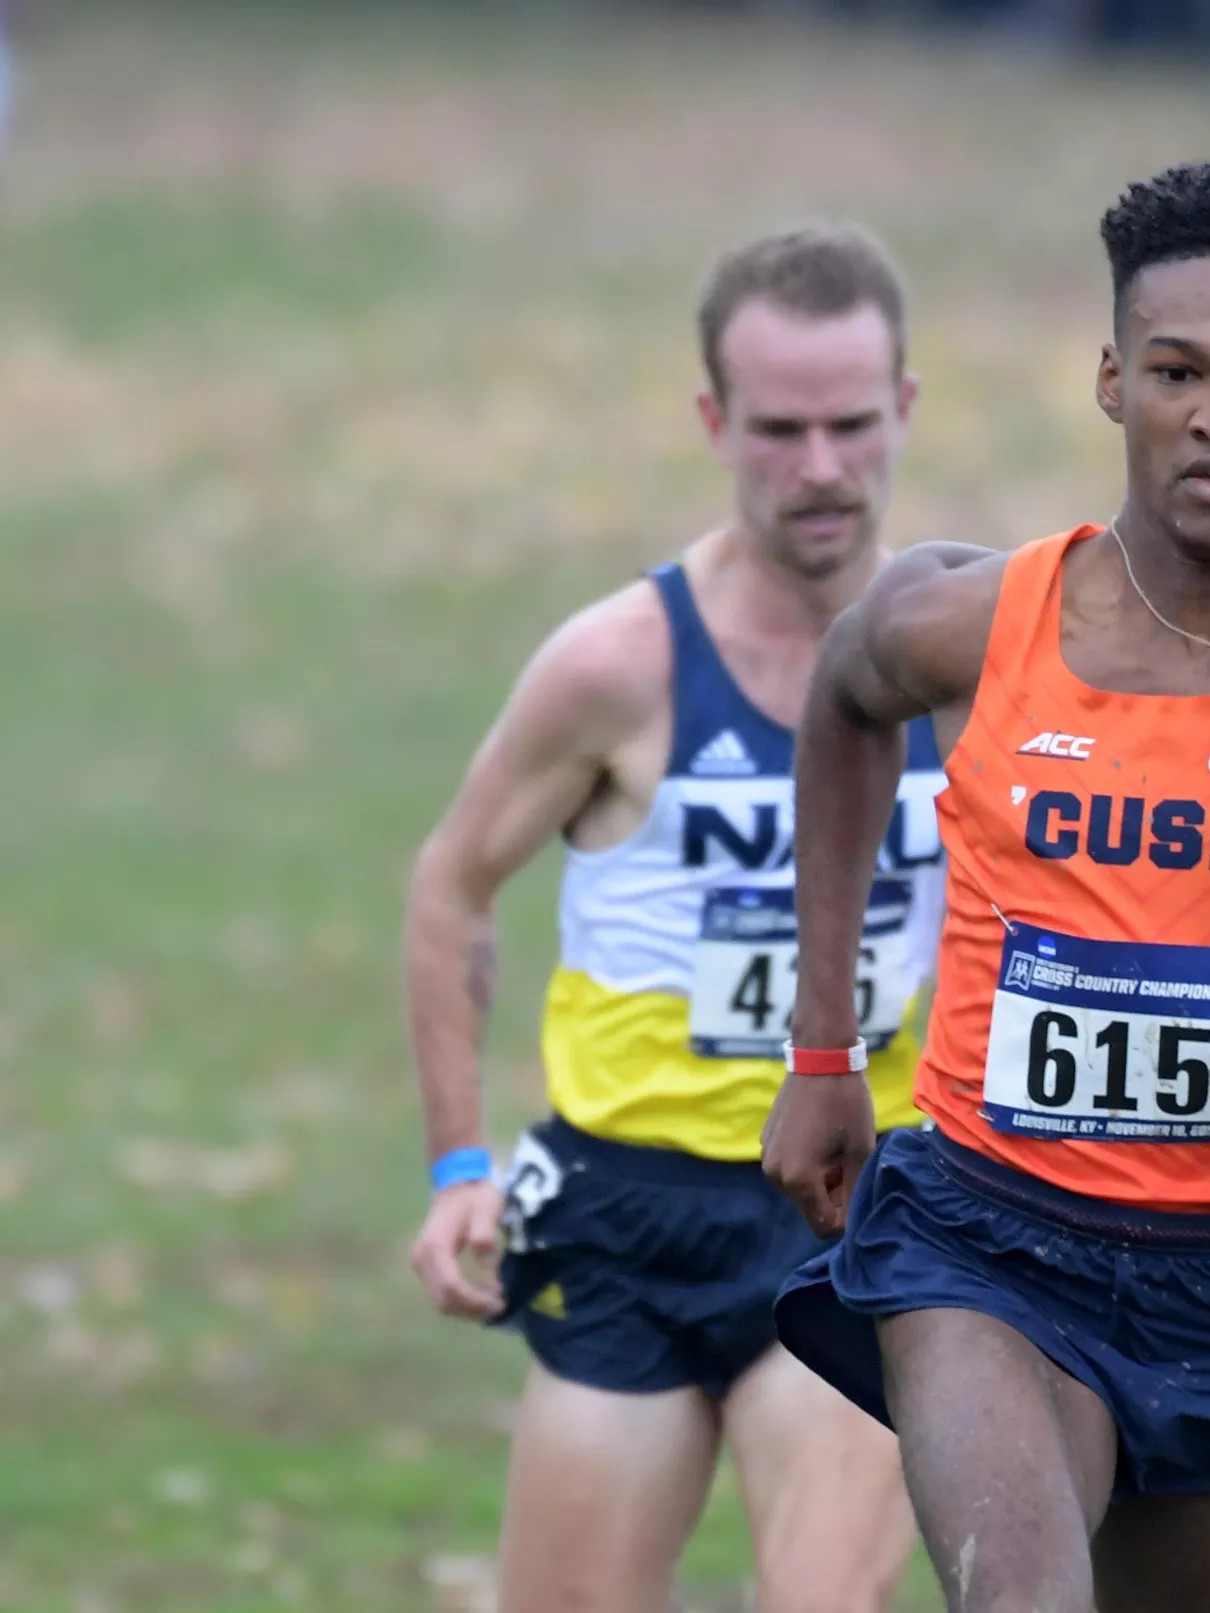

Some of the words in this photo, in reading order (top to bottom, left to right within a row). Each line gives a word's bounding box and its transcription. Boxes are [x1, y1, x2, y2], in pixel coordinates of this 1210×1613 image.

[1016, 731, 1097, 760] ACC
[730, 946, 877, 1031] 46
[1031, 964, 1074, 988] CROSS
[1074, 972, 1139, 996] COUNTRY
[1105, 1120, 1171, 1137] NOVEMBER
